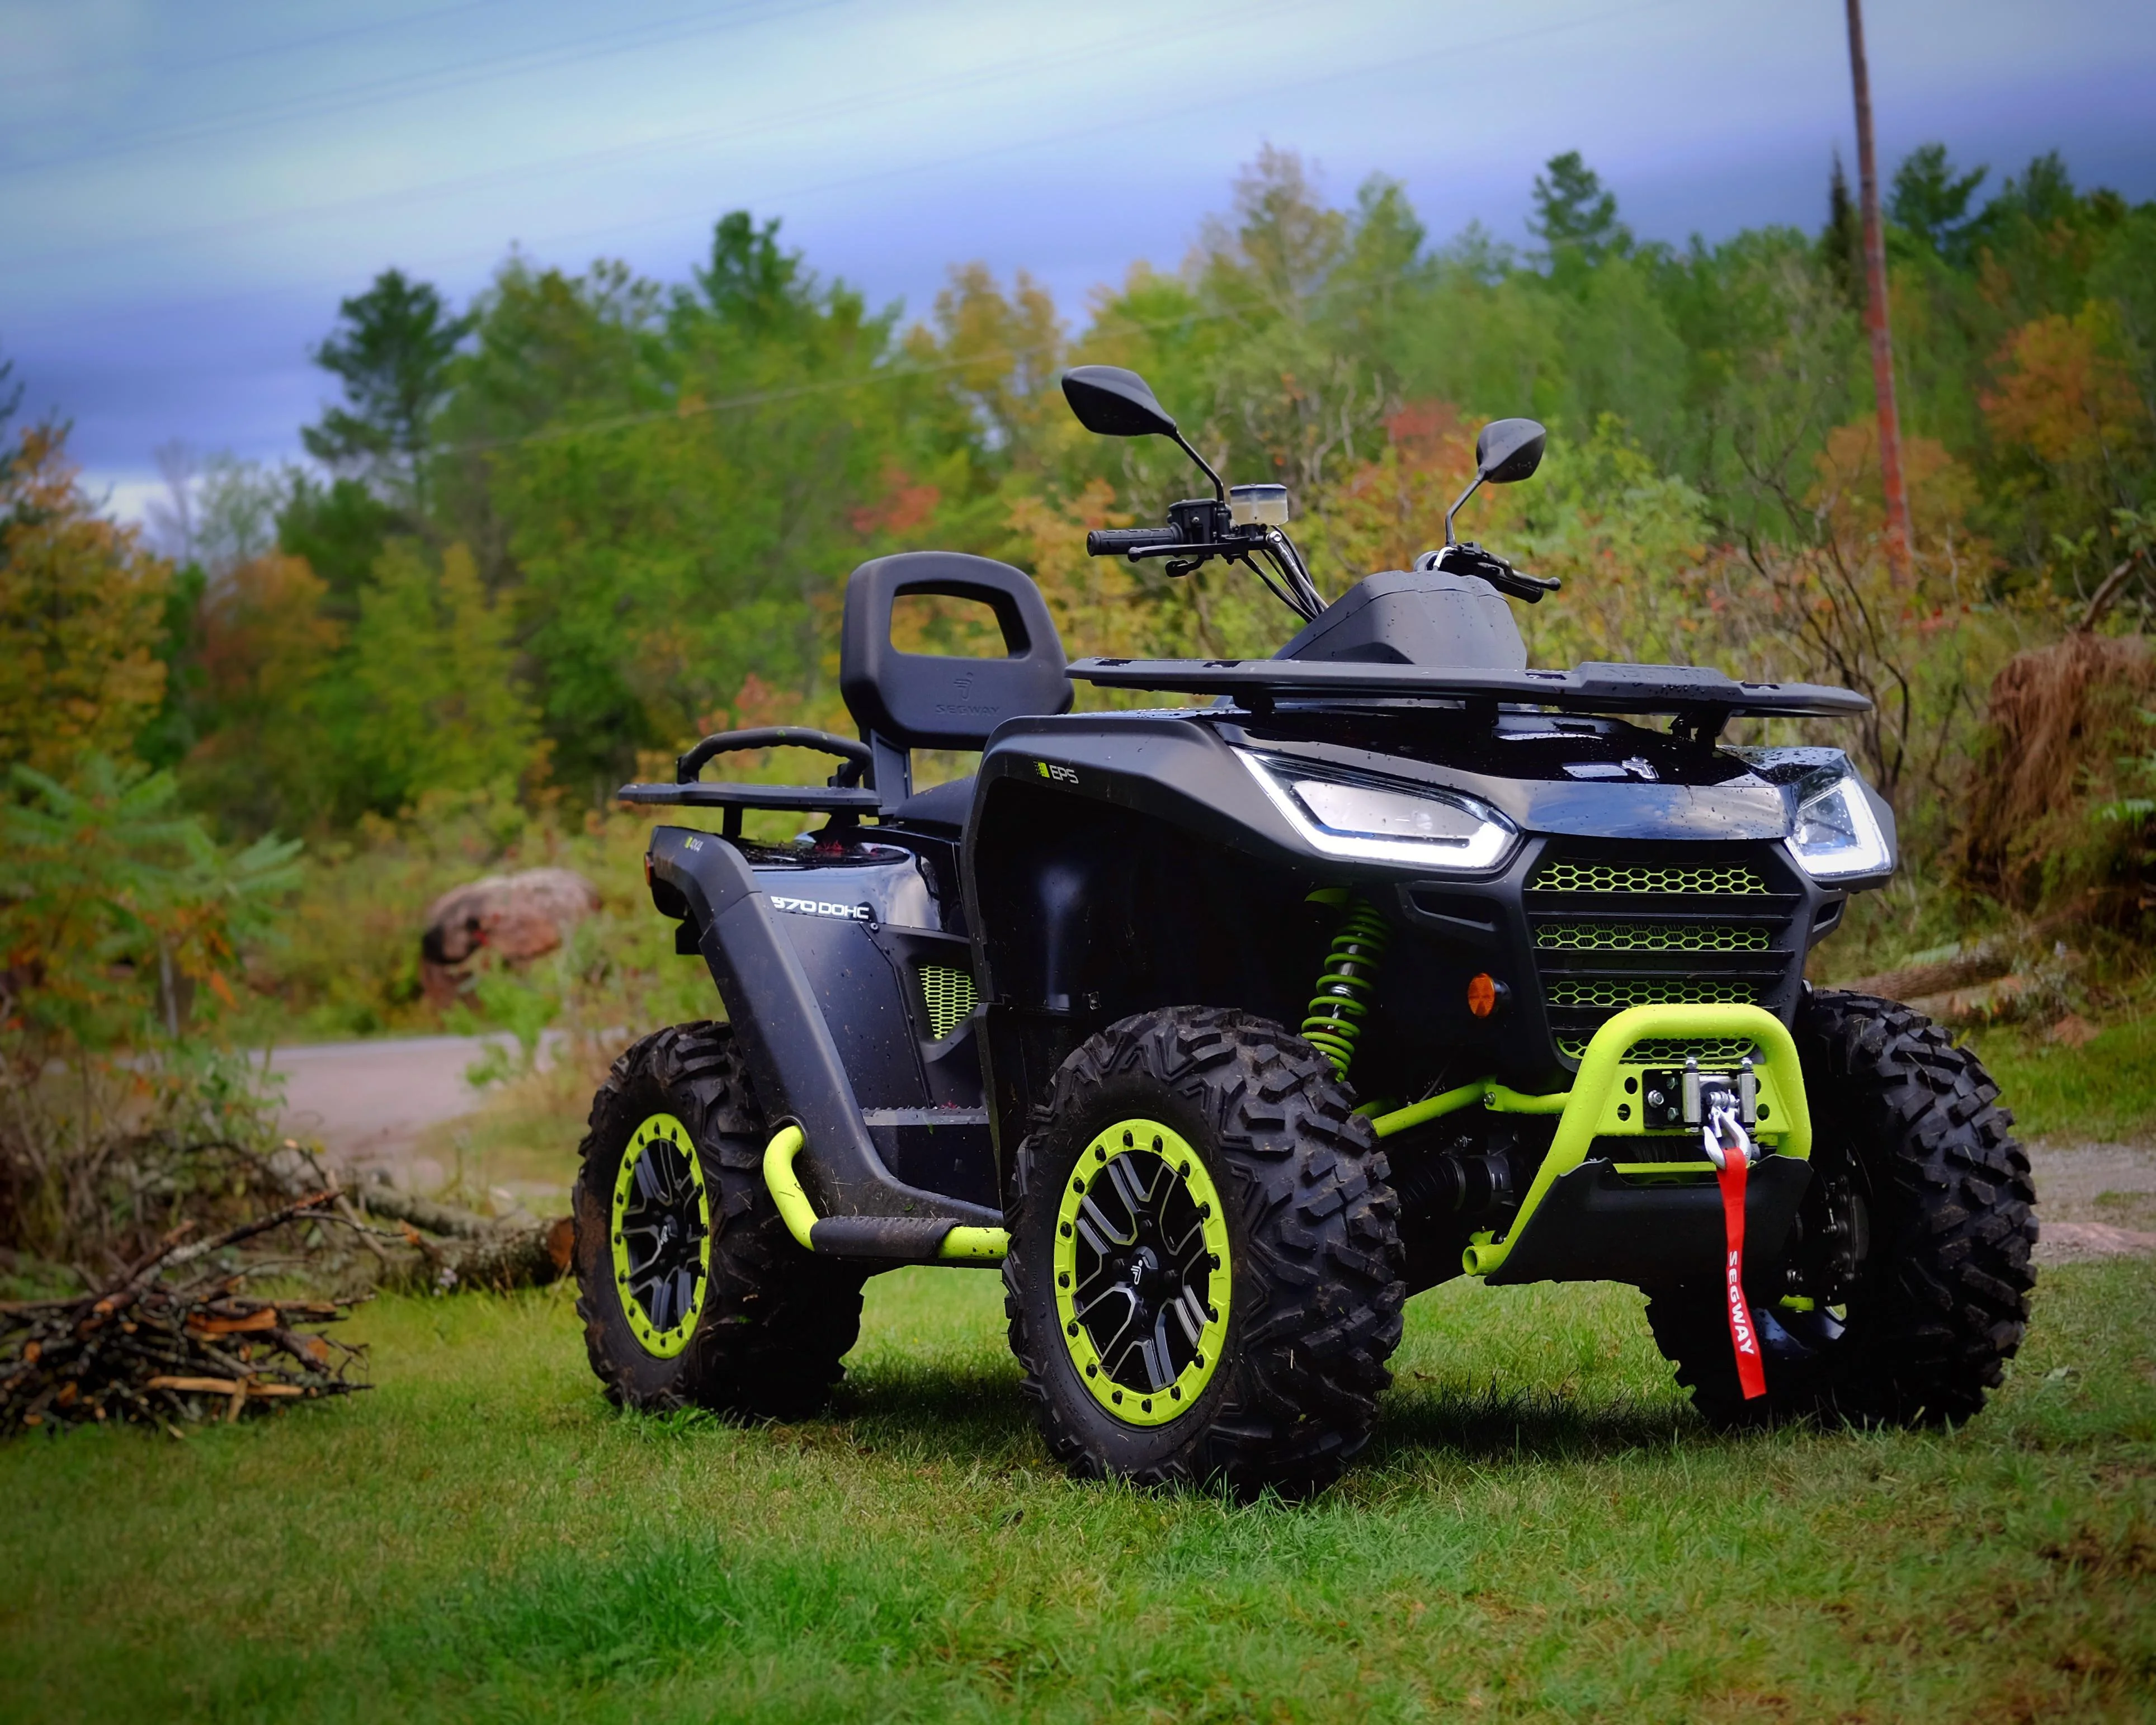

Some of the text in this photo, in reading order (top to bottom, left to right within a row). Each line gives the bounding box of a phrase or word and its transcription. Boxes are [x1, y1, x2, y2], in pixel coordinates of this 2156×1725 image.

[935, 704, 1001, 716] SEGWAY
[1049, 764, 1079, 784] EPS
[818, 901, 870, 920] DOHC
[1729, 1250, 1754, 1354] SEGWAY
